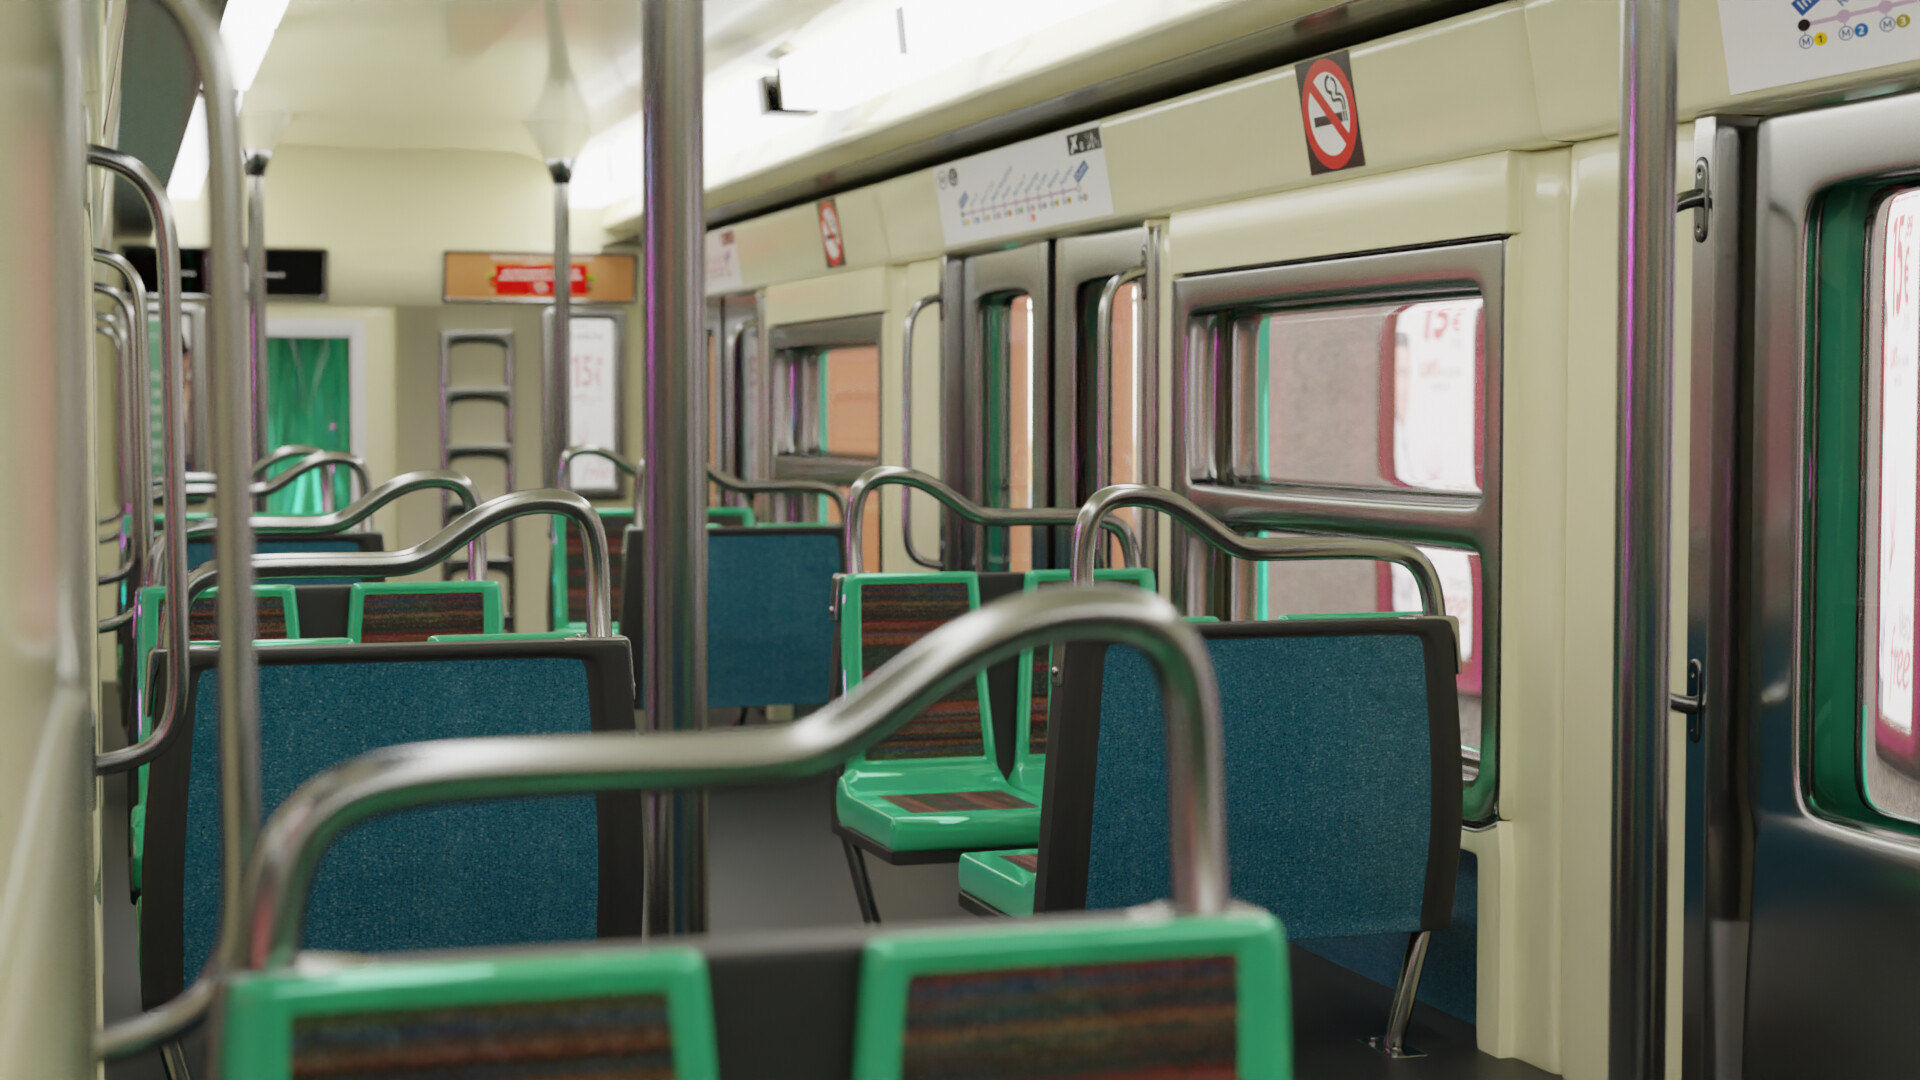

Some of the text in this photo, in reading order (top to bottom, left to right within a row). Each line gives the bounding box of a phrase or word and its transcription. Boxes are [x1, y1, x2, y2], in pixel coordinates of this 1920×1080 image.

[1900, 16, 1907, 26] 3
[1857, 25, 1866, 36] 2
[1889, 624, 1911, 703] free
